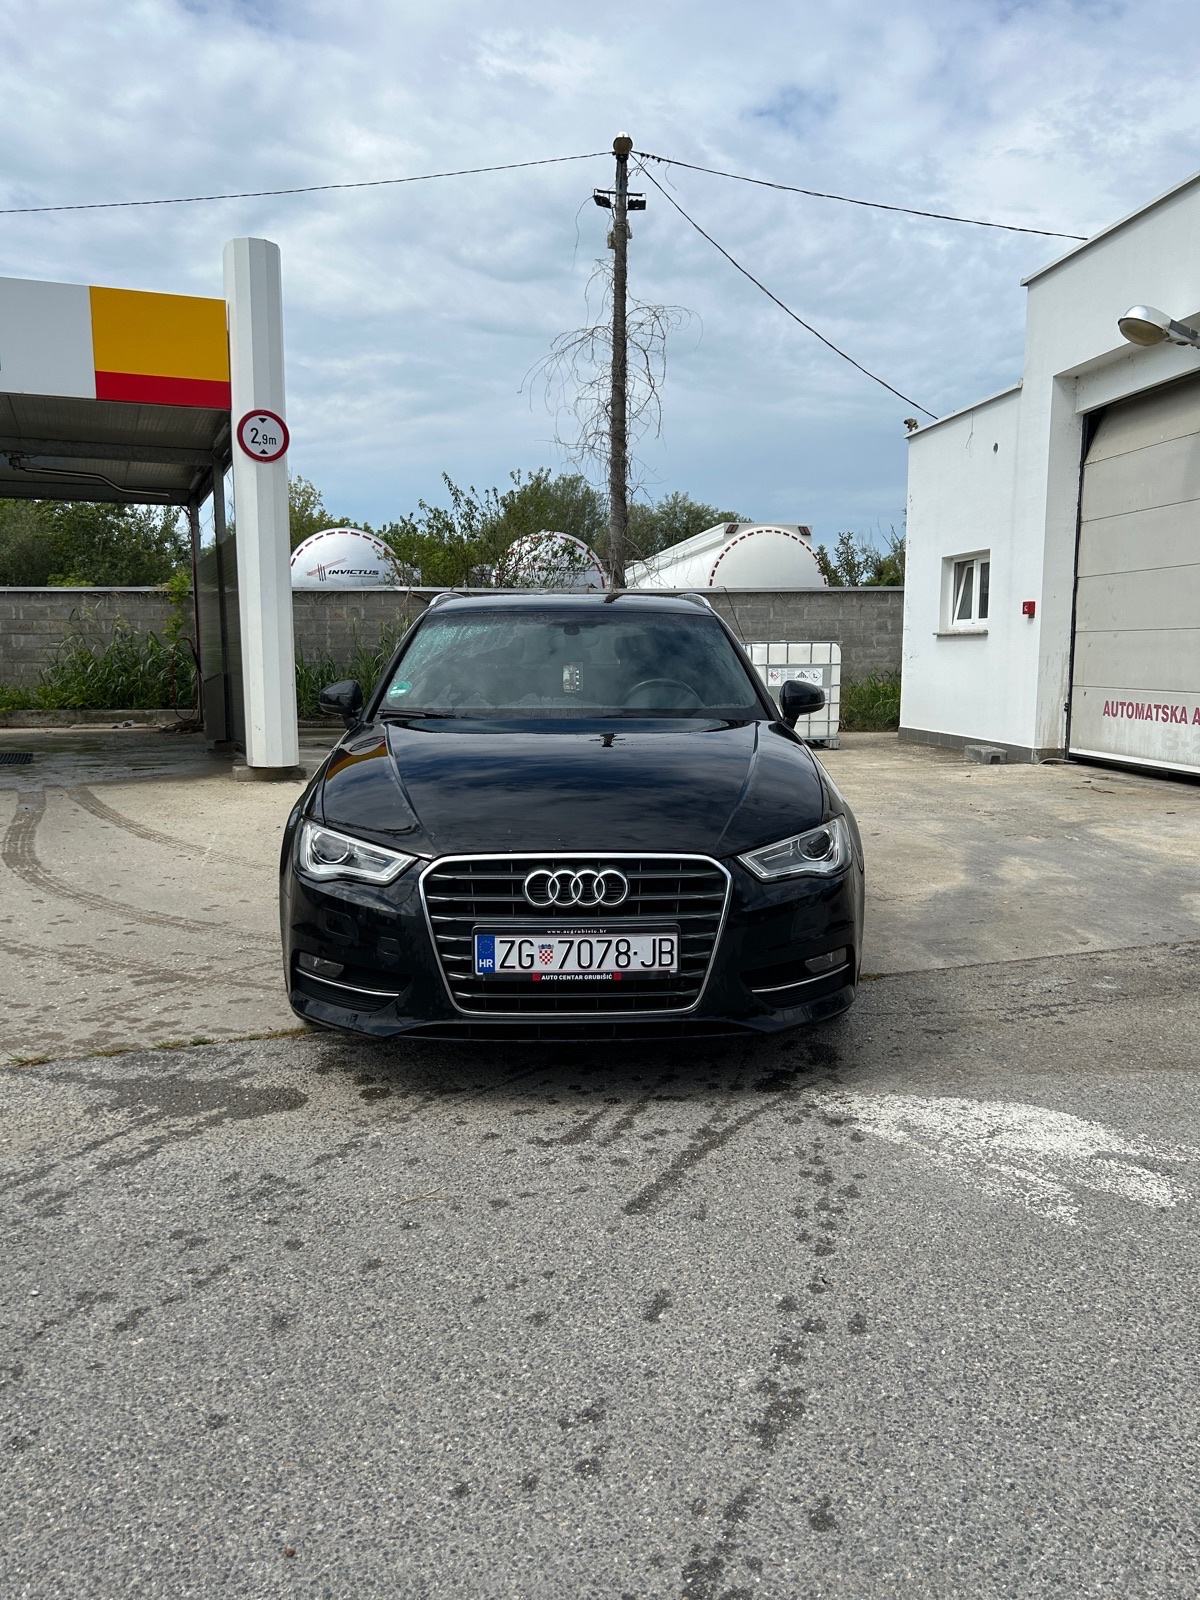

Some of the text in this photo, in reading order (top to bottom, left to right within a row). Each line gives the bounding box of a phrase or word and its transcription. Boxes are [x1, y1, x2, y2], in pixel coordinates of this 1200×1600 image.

[1102, 700, 1188, 725] AUTOMATSKA
[479, 958, 494, 968] HR
[499, 939, 535, 970] ZG
